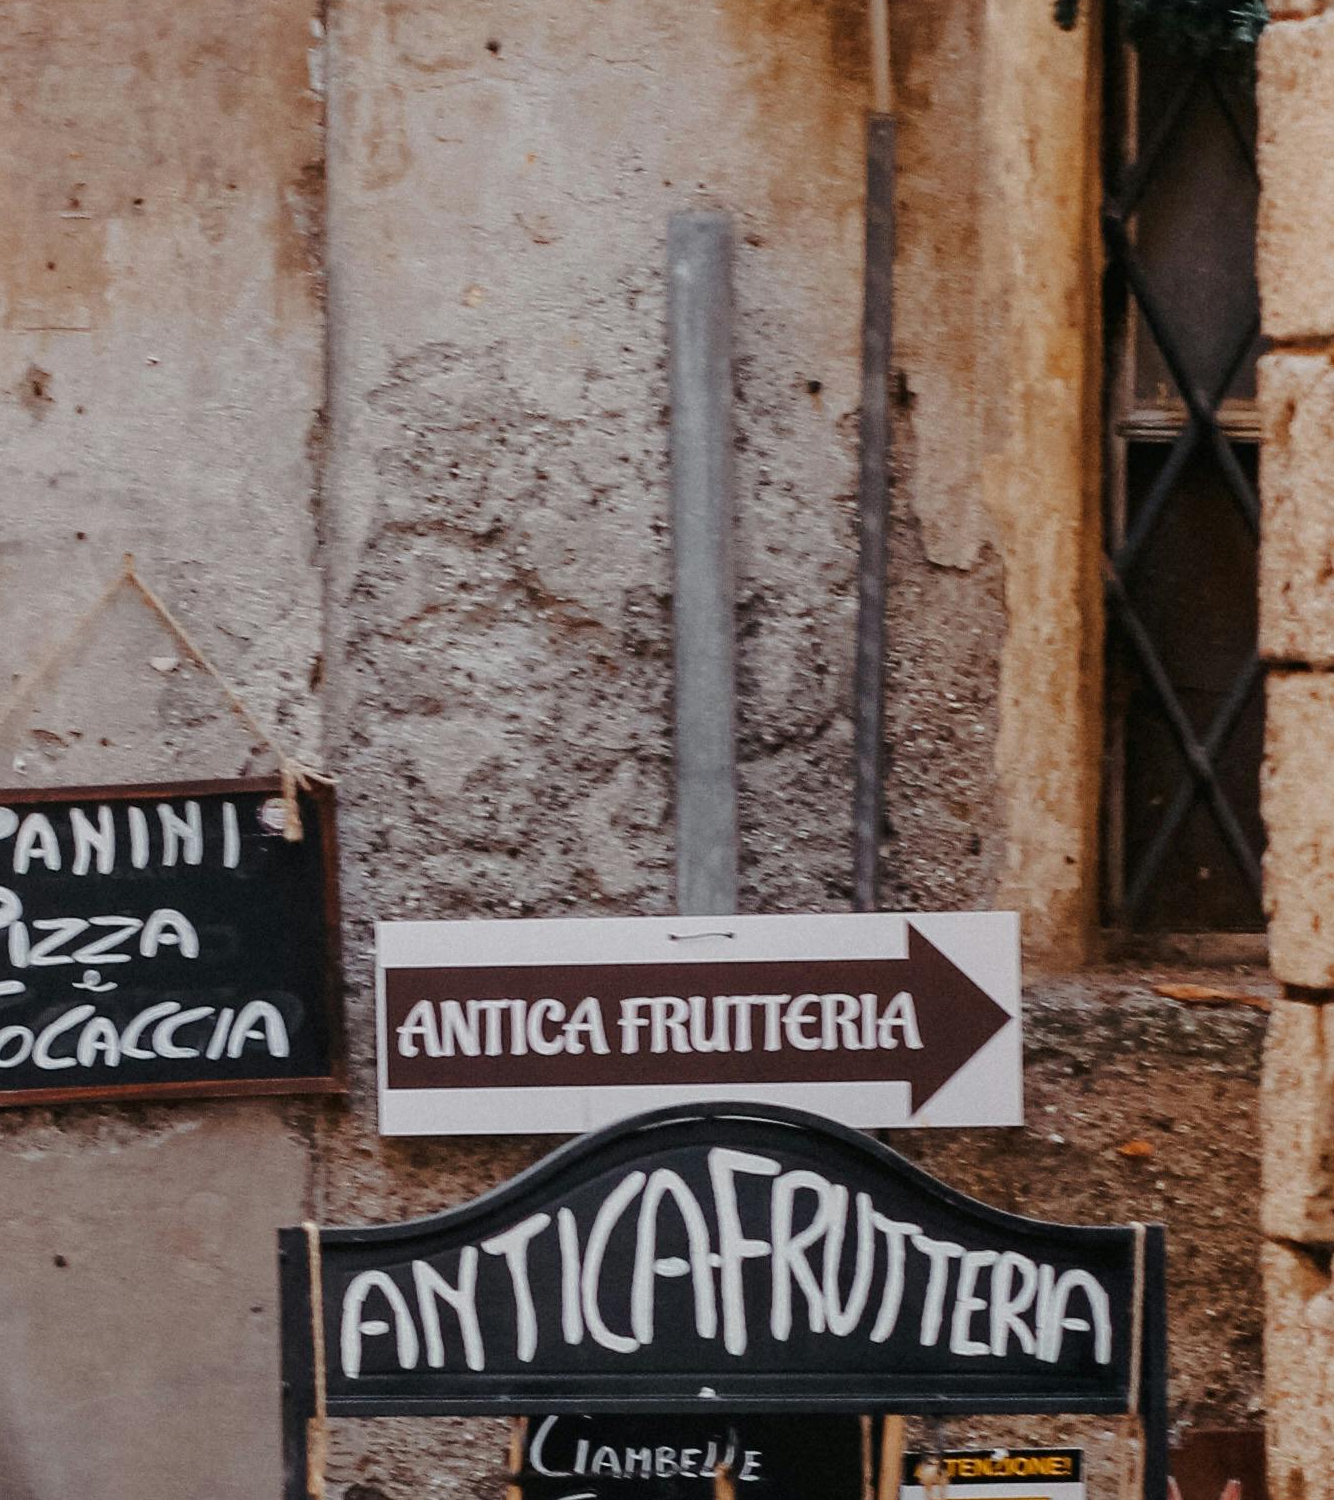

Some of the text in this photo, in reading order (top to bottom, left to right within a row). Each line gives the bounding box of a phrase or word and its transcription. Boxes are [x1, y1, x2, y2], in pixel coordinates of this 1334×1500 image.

[396, 990, 925, 1060] ANTICA FRUTTERIA
[339, 1146, 1112, 1380] ANTICA FRUTTERIA
[914, 1456, 1074, 1479] TENZIONE!
